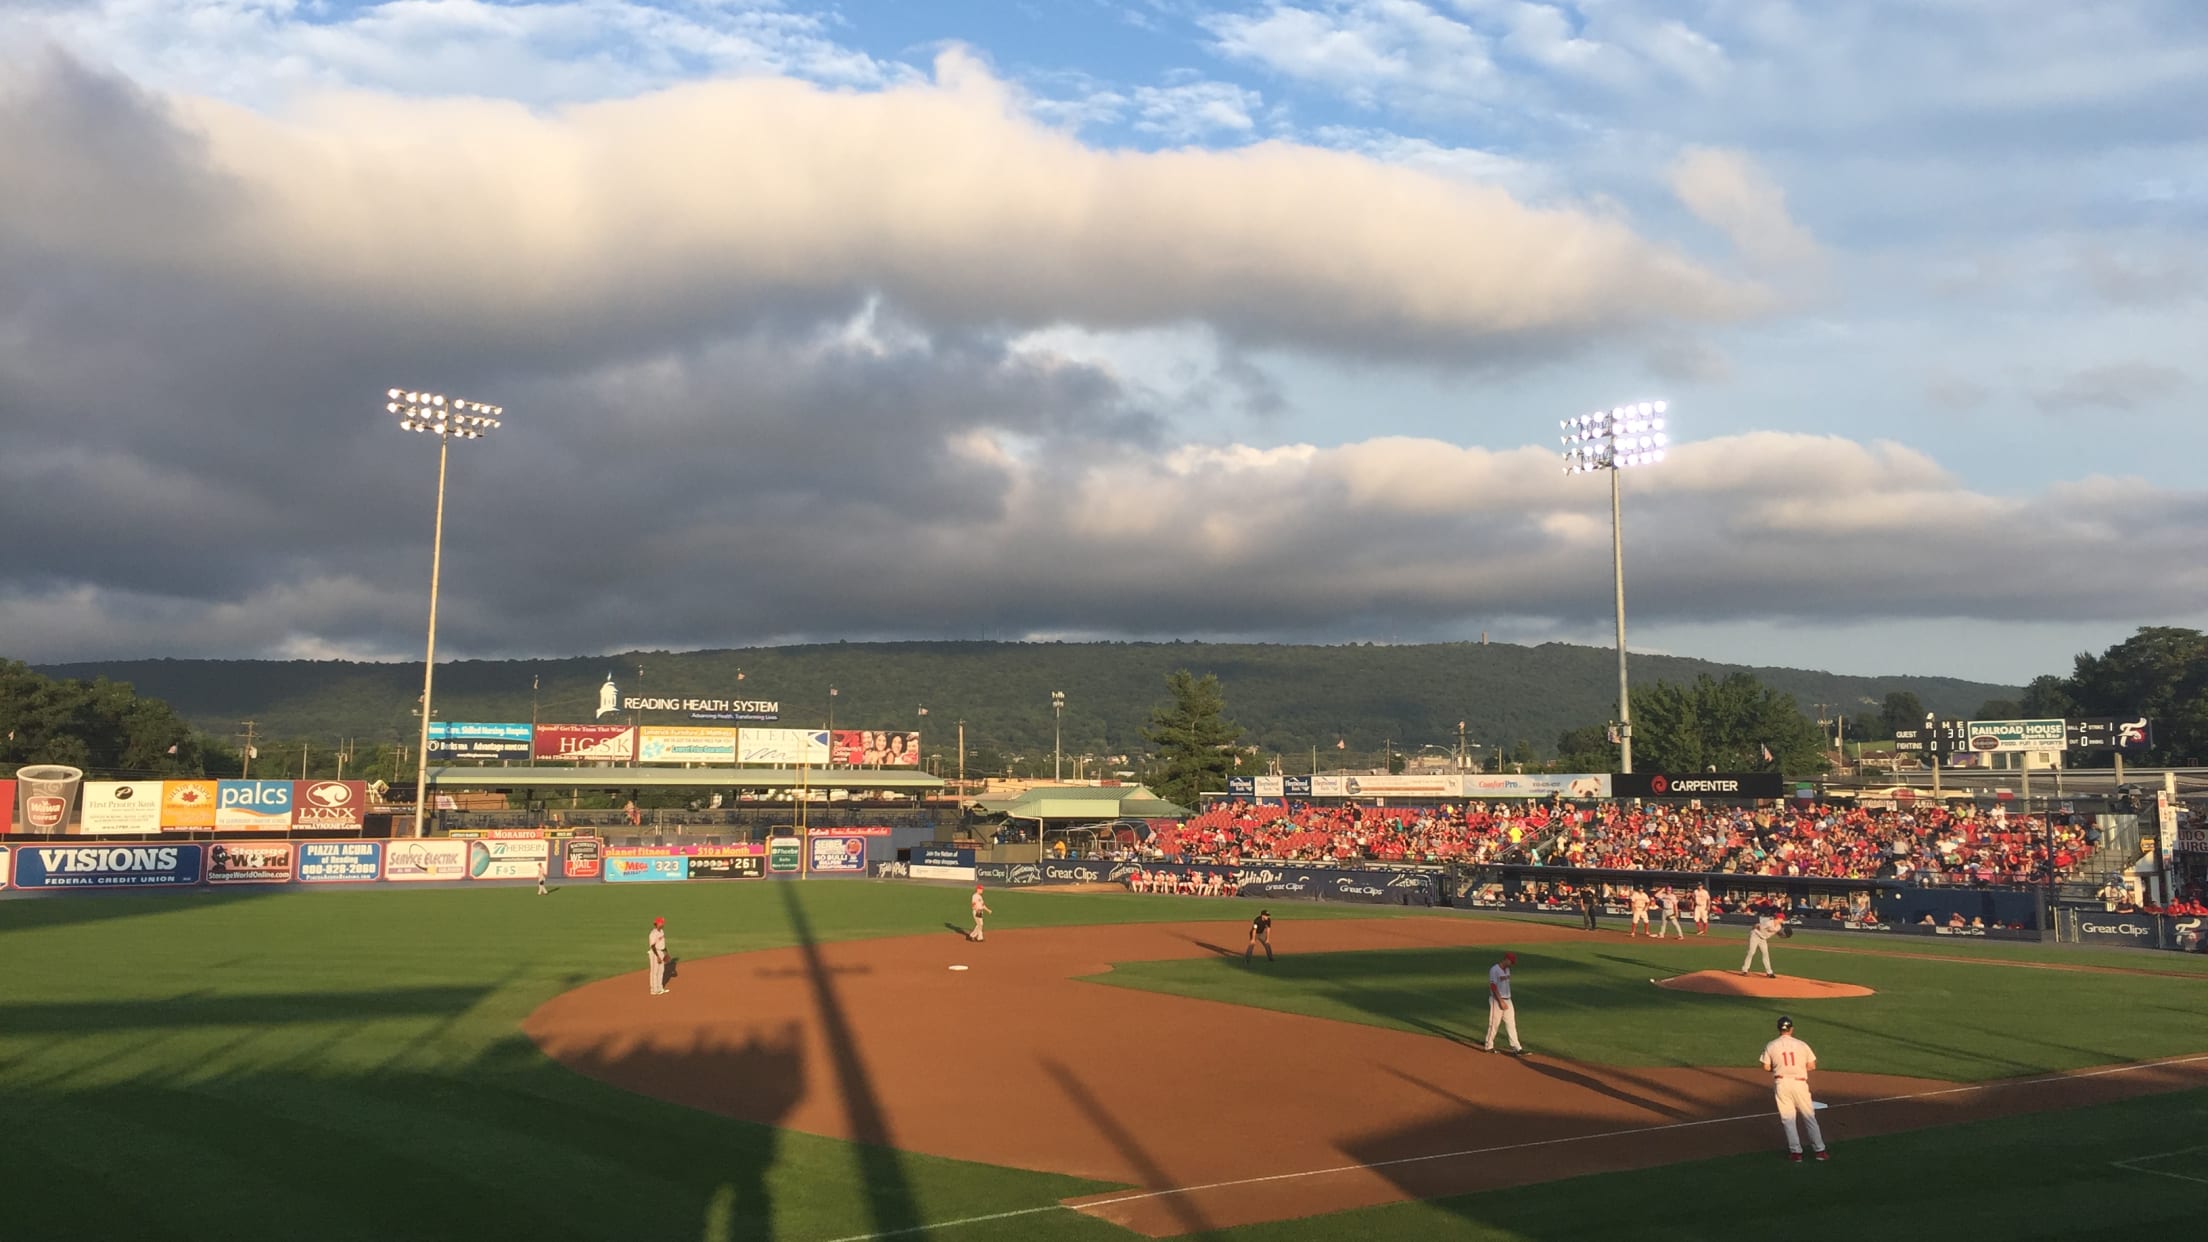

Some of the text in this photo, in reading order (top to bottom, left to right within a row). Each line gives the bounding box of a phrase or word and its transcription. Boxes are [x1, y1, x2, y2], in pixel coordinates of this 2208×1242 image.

[624, 697, 779, 713] READING HEALTH SYSTEM
[1925, 721, 1965, 730] R H E
[1971, 725, 2063, 736] RAILROAD HOUSE
[2080, 722, 2087, 733] 2
[1958, 729, 1965, 738] 0
[560, 736, 630, 754] HGSK
[1930, 741, 1937, 750] 0
[1958, 740, 1965, 750] 0
[2081, 736, 2088, 746] 0
[473, 742, 504, 752] Advantage
[1671, 780, 1739, 792] CARPENTER
[221, 782, 287, 809] palcs
[31, 802, 61, 812] Wawa
[299, 807, 356, 819] LYNX
[494, 831, 536, 839] MORABITO
[231, 848, 286, 856] Storage
[307, 845, 373, 855] PIAZZA ACURA
[507, 844, 545, 852] HERBEIN
[605, 848, 670, 857] planet fitness
[721, 847, 750, 855] Month
[39, 848, 178, 872] VISIONS
[389, 853, 459, 865] SERVICE ELECTRIC
[208, 872, 290, 880] StorageWorldOnline.com
[978, 869, 991, 877] Great
[992, 869, 1005, 878] Clips
[1046, 866, 1073, 878] Great
[1074, 867, 1097, 882] Clips
[45, 877, 93, 885] FEDERAL
[1265, 882, 1303, 891] Great Clips
[1340, 885, 1382, 896] Great Clips
[2082, 922, 2149, 937] Great Clips
[1782, 1051, 1796, 1066] 11
